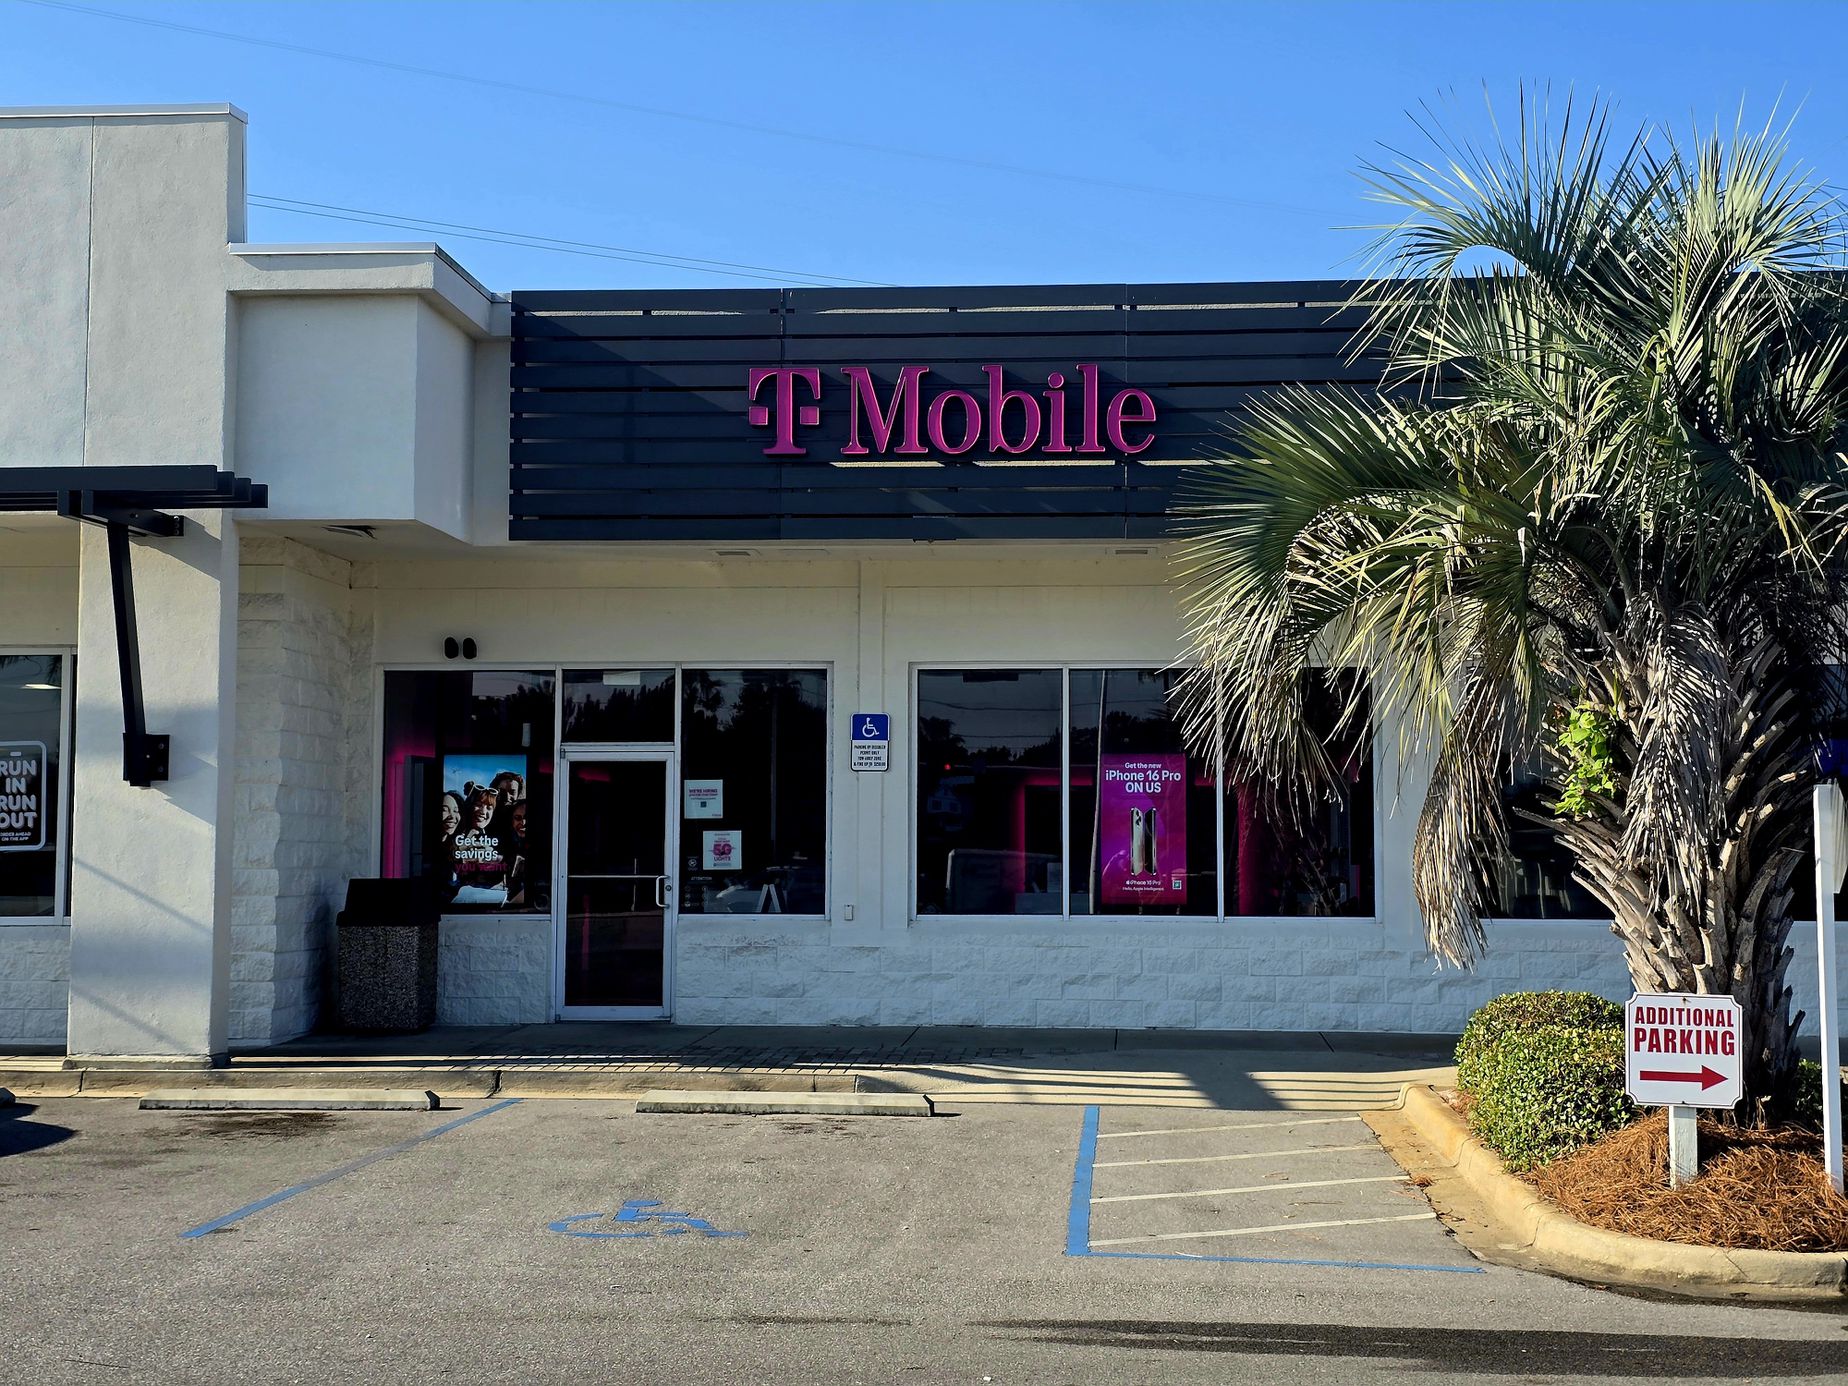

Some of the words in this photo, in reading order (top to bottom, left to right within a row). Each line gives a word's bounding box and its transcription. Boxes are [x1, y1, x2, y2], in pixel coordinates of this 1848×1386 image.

[840, 363, 1157, 454] Mobile
[0, 760, 37, 776] RUN
[1105, 770, 1144, 781] iPhone
[1146, 770, 1160, 781] 16
[1162, 770, 1181, 781] Pro
[5, 777, 27, 794] IN
[1125, 782, 1143, 793] ON
[1146, 782, 1162, 793] US
[0, 794, 37, 812] RUN
[0, 812, 38, 829] OUT
[455, 835, 477, 846] Get
[479, 835, 498, 846] the
[454, 848, 498, 861] savings
[713, 844, 732, 856] 5G
[454, 863, 475, 873] you
[1634, 1006, 1734, 1028] ADDITIONAL
[1634, 1027, 1735, 1056] PARKING
